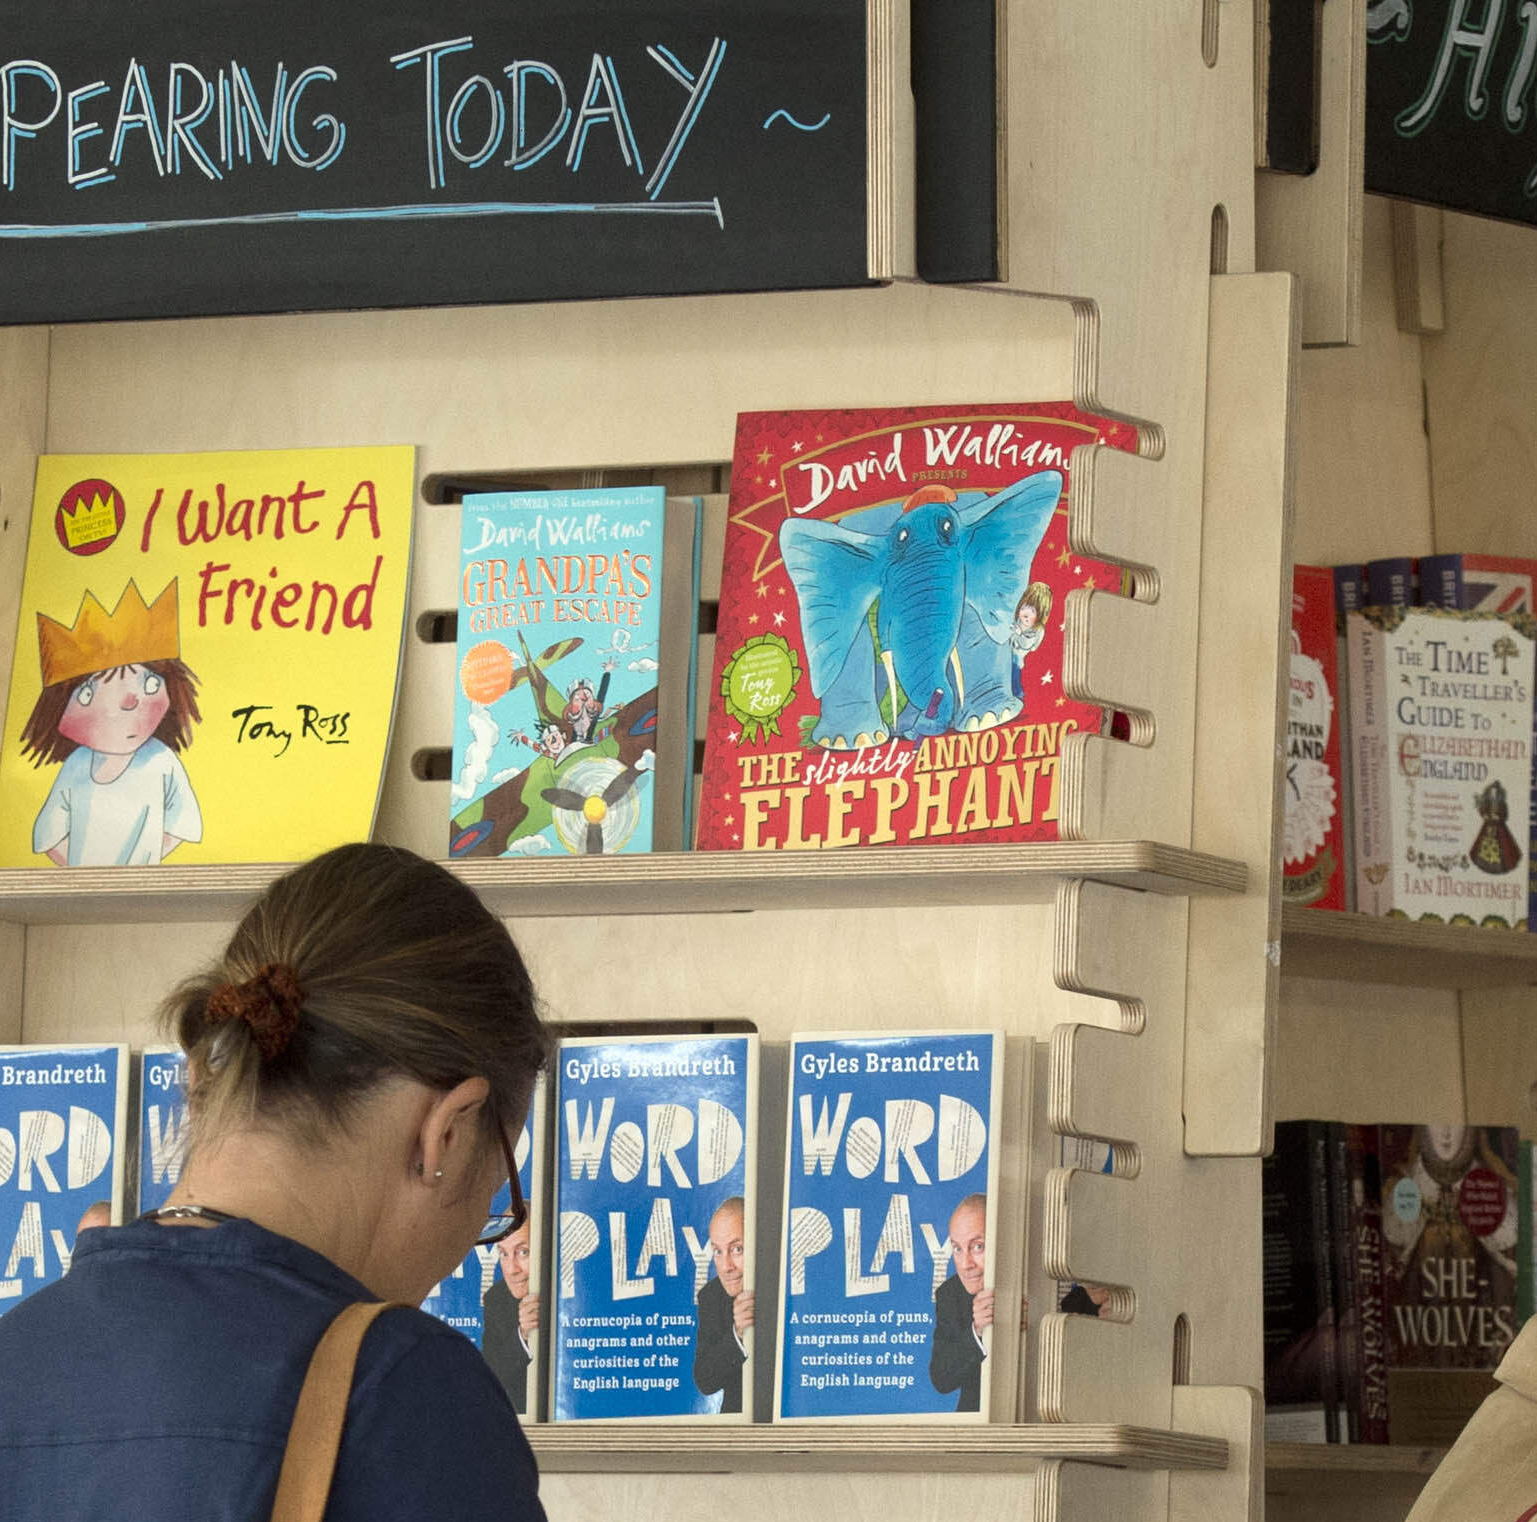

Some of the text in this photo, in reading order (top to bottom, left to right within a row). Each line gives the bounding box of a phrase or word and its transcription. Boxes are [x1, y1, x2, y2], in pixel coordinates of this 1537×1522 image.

[389, 35, 728, 201] TODAY
[793, 433, 906, 514] David
[139, 479, 383, 553] I Want A
[462, 512, 652, 555] David Walliams
[197, 555, 385, 635] Friend
[462, 548, 653, 608] GRANDPA'S
[470, 598, 643, 633] GREAT ESCAPE
[1395, 640, 1490, 675] THE TIME
[1417, 675, 1528, 703] TRAVELLER'S
[1397, 696, 1466, 728] GUIDE
[231, 703, 352, 758] Tony Ross
[737, 750, 805, 789] THE
[802, 736, 917, 789] slightly
[739, 755, 1063, 852] ELEPHANT
[1404, 874, 1523, 900] IAN MORTIMER
[1, 1064, 108, 1086] Brandreth
[149, 1066, 188, 1091] Gyl
[565, 1055, 736, 1084] Gyles Brandreth
[800, 1051, 980, 1080] Gyles Brandreth
[564, 1096, 744, 1189] WORD
[798, 1091, 987, 1186] WORD
[559, 1197, 714, 1306] PLAY
[790, 1193, 953, 1303] PLAY
[1422, 1255, 1489, 1300] SHE-
[447, 1314, 481, 1330] puns,
[562, 1311, 696, 1331] A cornucopia of puns,
[790, 1309, 933, 1328] A cornucopia of puns,
[1394, 1305, 1513, 1348] WOLVES
[566, 1333, 691, 1352] anagrams and other
[794, 1330, 927, 1349] anagrams and other
[573, 1353, 679, 1370] curiosities of the
[801, 1351, 914, 1366] curiosities of the
[572, 1374, 680, 1392] English language
[800, 1373, 915, 1390] English language
